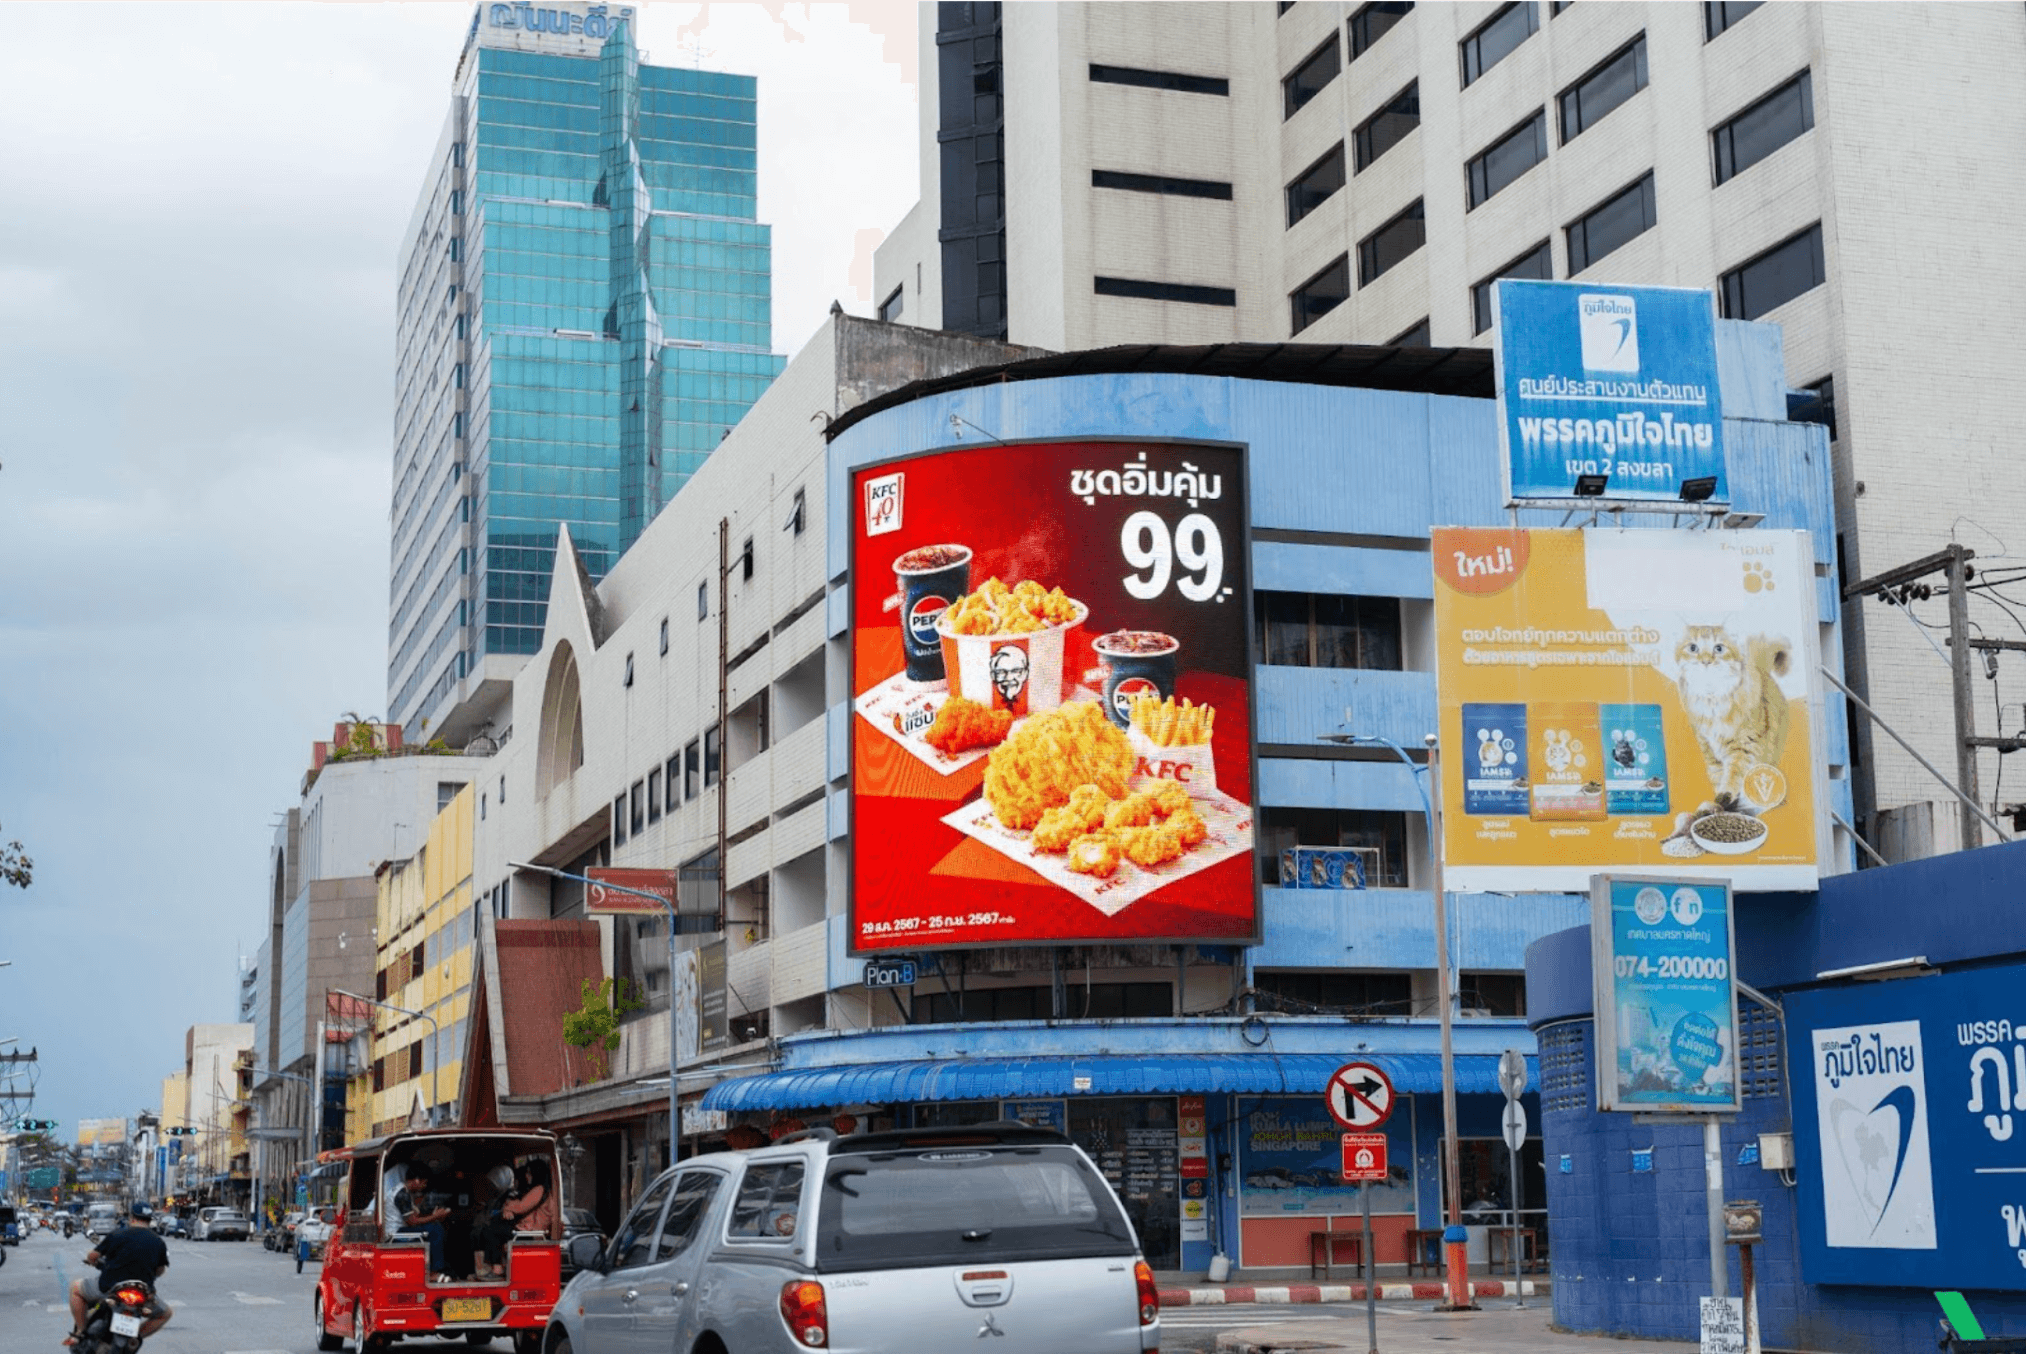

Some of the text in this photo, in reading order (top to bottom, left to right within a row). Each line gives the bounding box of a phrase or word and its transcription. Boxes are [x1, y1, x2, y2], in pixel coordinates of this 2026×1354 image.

[1518, 411, 1713, 454] พรรคภูมิใจไทย
[1565, 459, 1673, 477] เขต 2 สงขลา
[872, 483, 897, 499] KFC
[1071, 452, 1221, 508] ชุดอิ่มคุ้ม
[1453, 546, 1514, 577] ใหม่!
[912, 615, 938, 627] PEP
[1462, 626, 1660, 648] ตอบโจทย์ทุกความแตกต่าง
[1135, 756, 1193, 782] KFC
[861, 922, 874, 934] 29
[893, 917, 920, 931] 2567
[928, 915, 943, 928] 25
[967, 912, 999, 925] 2567
[1615, 955, 1727, 980] 074-200000
[1956, 1019, 2012, 1046] พรรค
[1820, 1041, 1839, 1051] พรรค
[1824, 1032, 1915, 1088] ภูมิใจไทย
[1294, 1121, 1345, 1132] LUMPU
[1250, 1140, 1322, 1152] SINGAPORE
